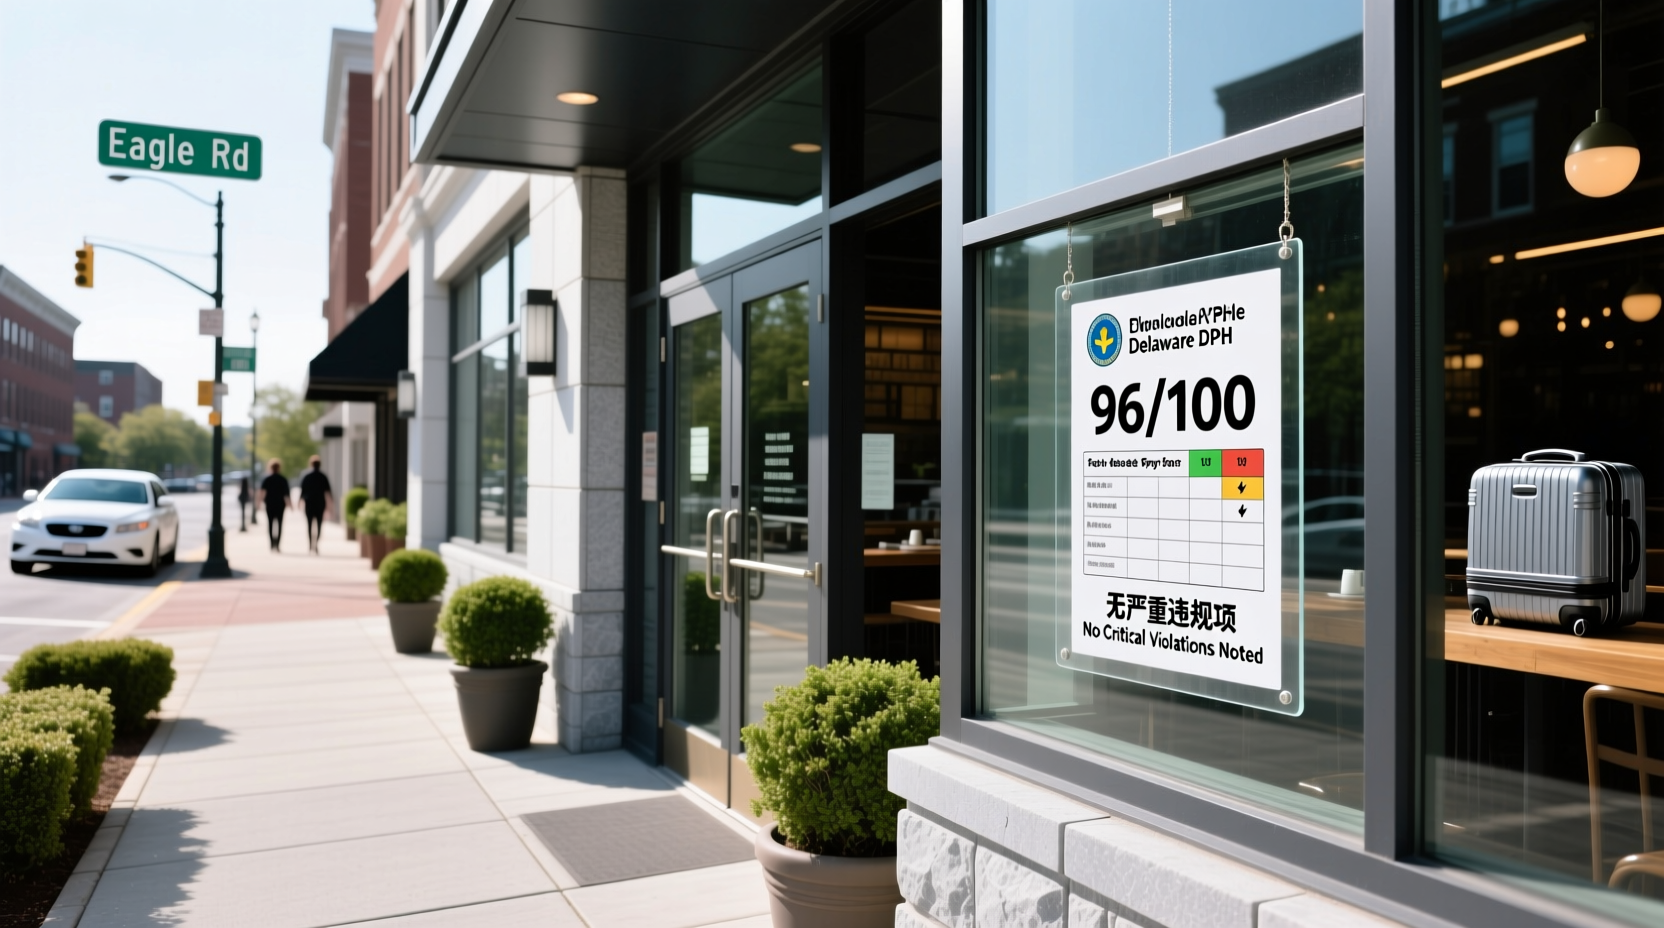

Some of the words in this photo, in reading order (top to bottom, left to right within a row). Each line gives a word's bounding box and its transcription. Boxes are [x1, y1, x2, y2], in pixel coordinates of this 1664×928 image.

[109, 127, 194, 170] Eagle
[212, 138, 249, 172] Rd
[1129, 335, 1194, 354] Delaware
[1199, 326, 1233, 347] DPH
[1091, 374, 1256, 438] 96/100
[1106, 592, 1237, 633] 无严重违规项
[1083, 621, 1101, 638] No
[1103, 624, 1146, 646] Critical
[1149, 630, 1215, 656] Violations
[1219, 641, 1263, 664] Noted
